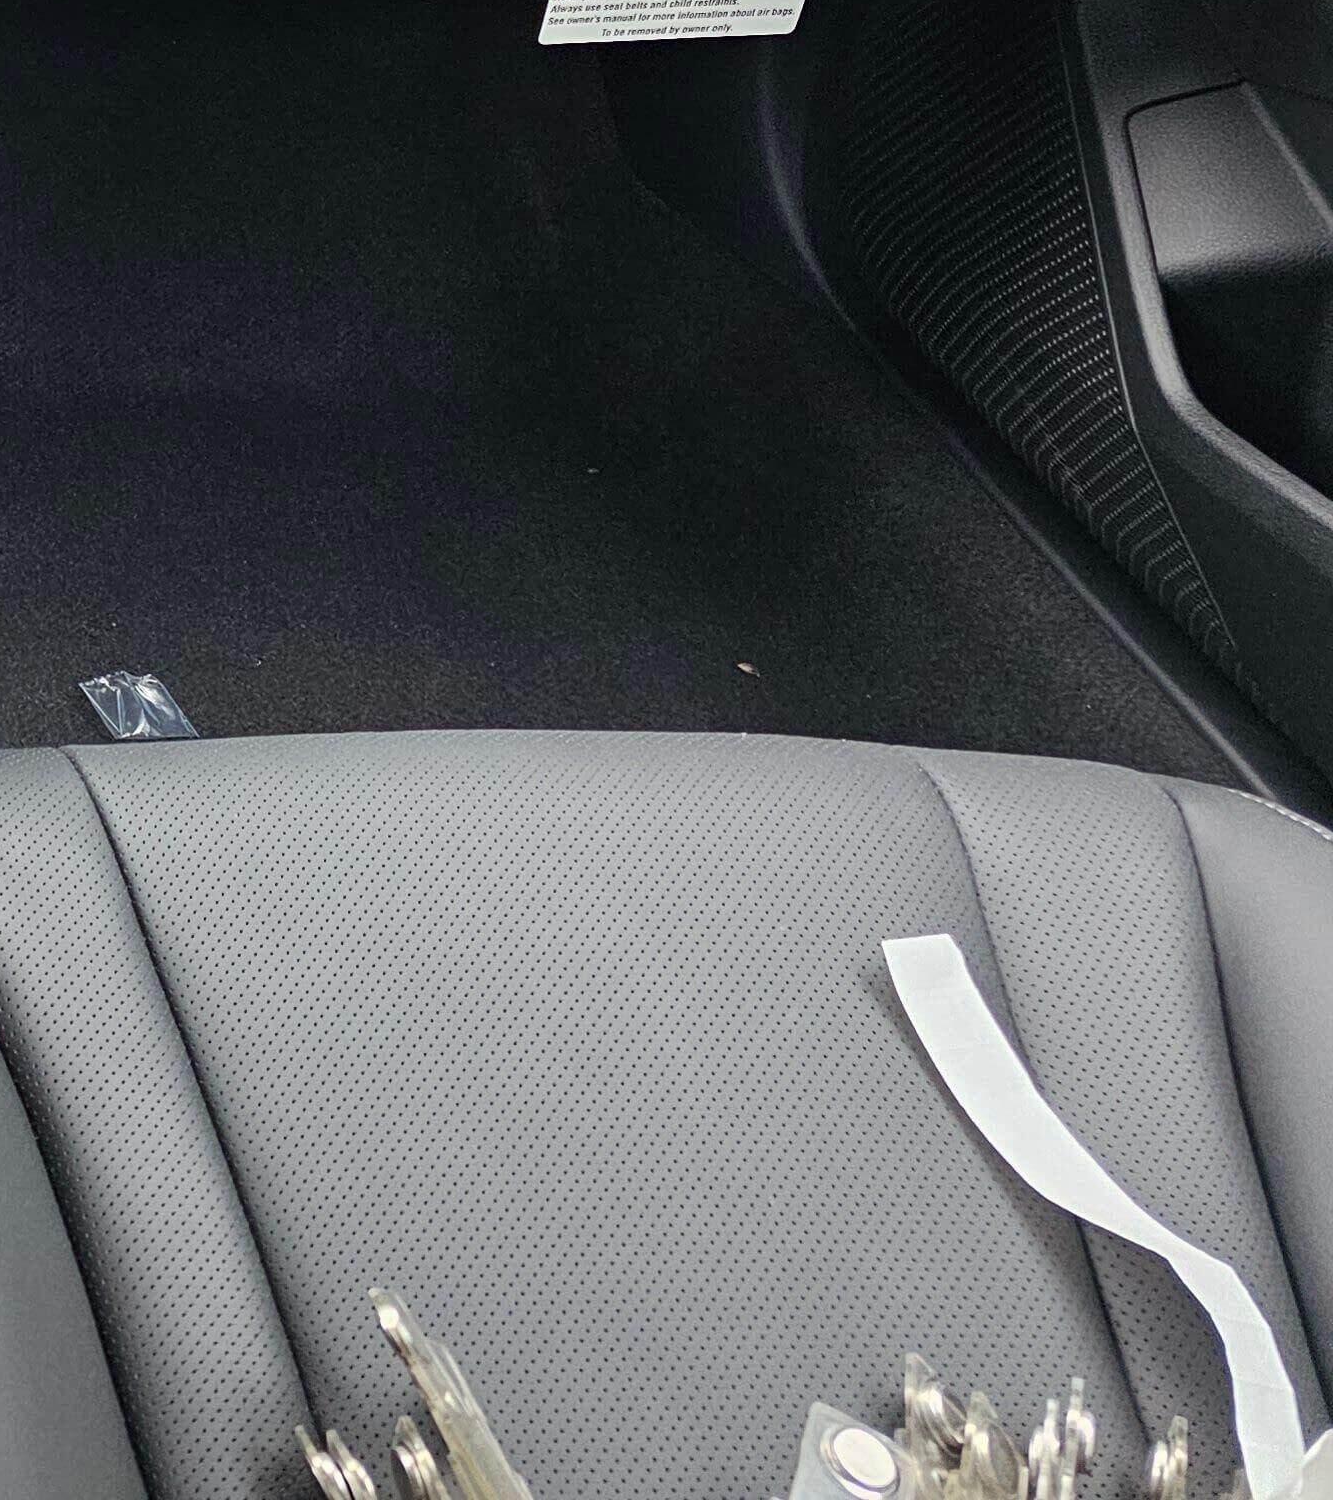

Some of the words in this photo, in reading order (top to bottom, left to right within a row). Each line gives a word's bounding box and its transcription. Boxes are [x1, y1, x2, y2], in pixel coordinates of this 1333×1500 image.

[550, 4, 583, 14] Always
[603, 2, 623, 11] seat
[626, 1, 648, 10] belts
[649, 0, 667, 8] and
[669, 0, 692, 8] child
[547, 17, 564, 25] See
[567, 16, 600, 25] owner's
[603, 14, 636, 23] manual
[638, 13, 651, 22] for
[653, 13, 675, 21] more
[678, 9, 727, 20] information
[730, 8, 756, 18] about
[757, 8, 770, 16] air
[772, 7, 795, 17] bags.
[601, 29, 612, 37] To
[613, 28, 625, 37] be
[627, 27, 666, 36] removed
[669, 26, 680, 35] by
[682, 25, 709, 34] owner
[711, 23, 733, 33] only.
